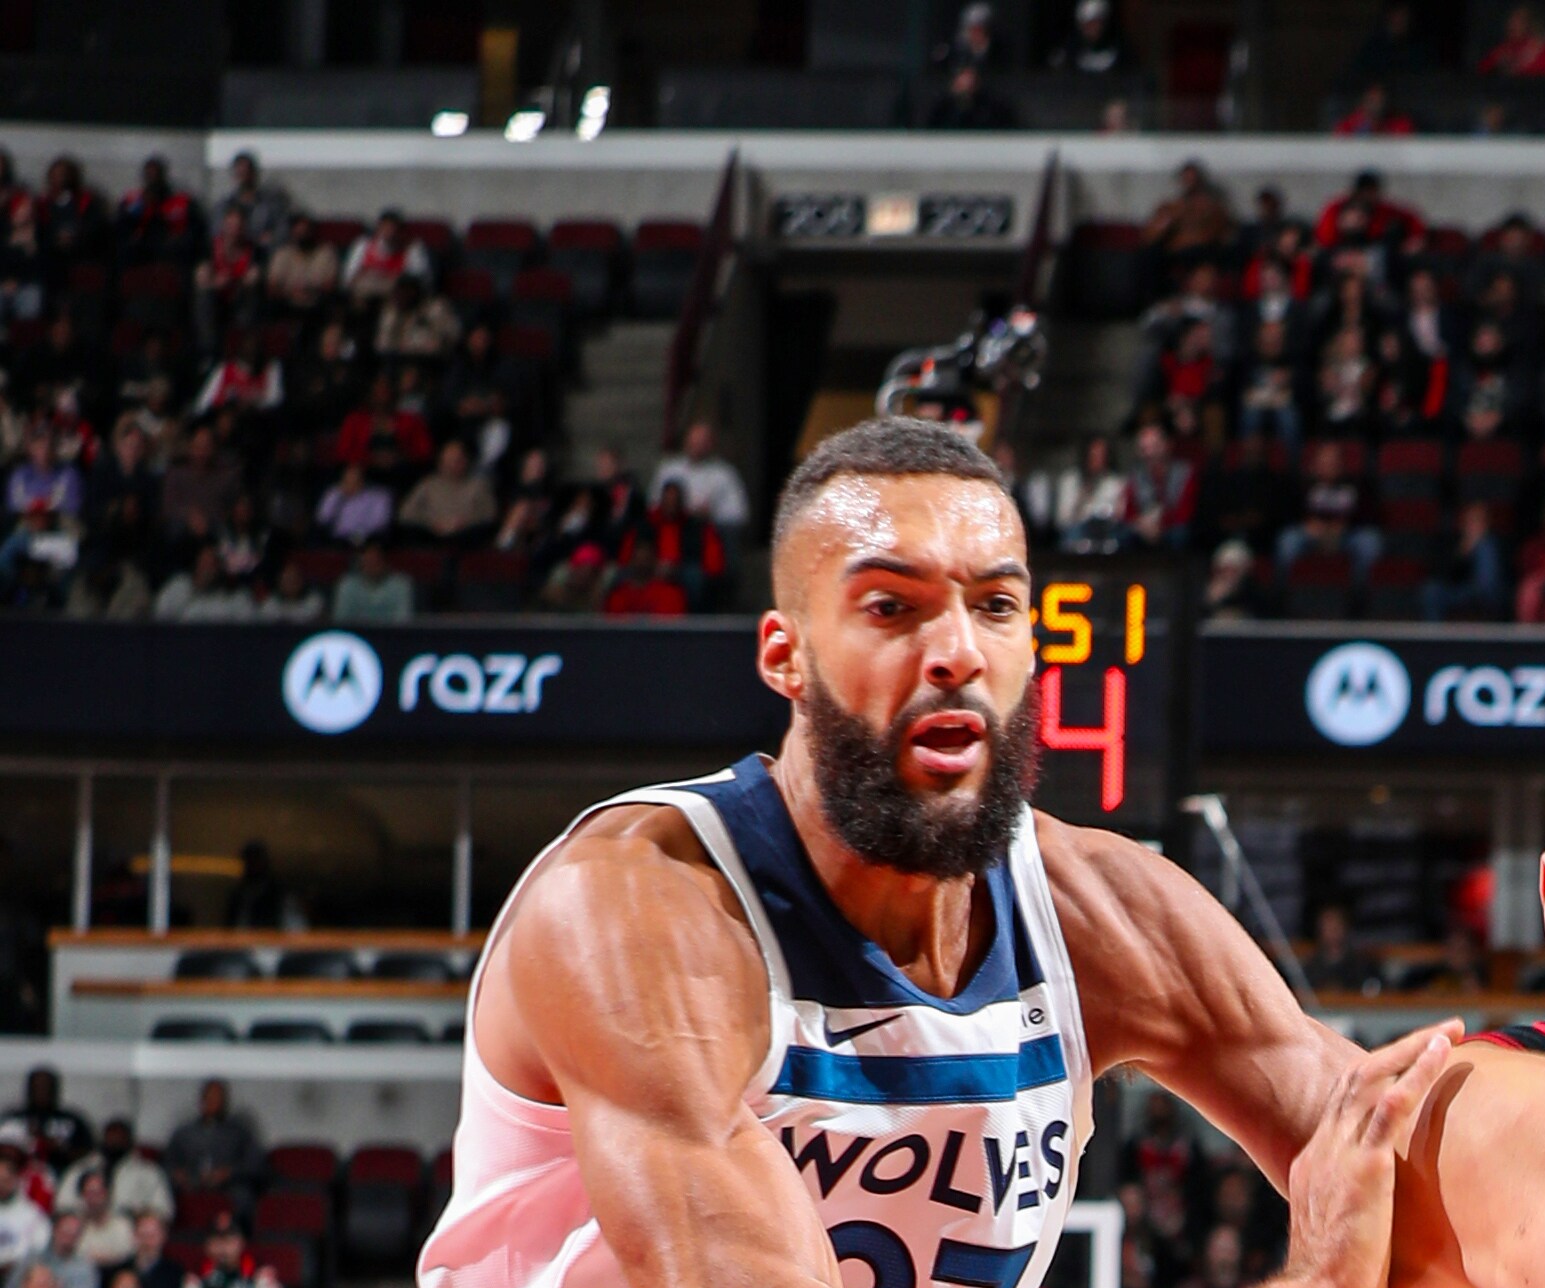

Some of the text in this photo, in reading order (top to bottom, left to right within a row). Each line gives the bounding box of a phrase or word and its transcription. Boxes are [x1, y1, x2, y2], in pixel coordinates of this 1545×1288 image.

[400, 653, 563, 713] razr
[1040, 665, 1126, 812] 4
[780, 1119, 1069, 1217] WOLVES
